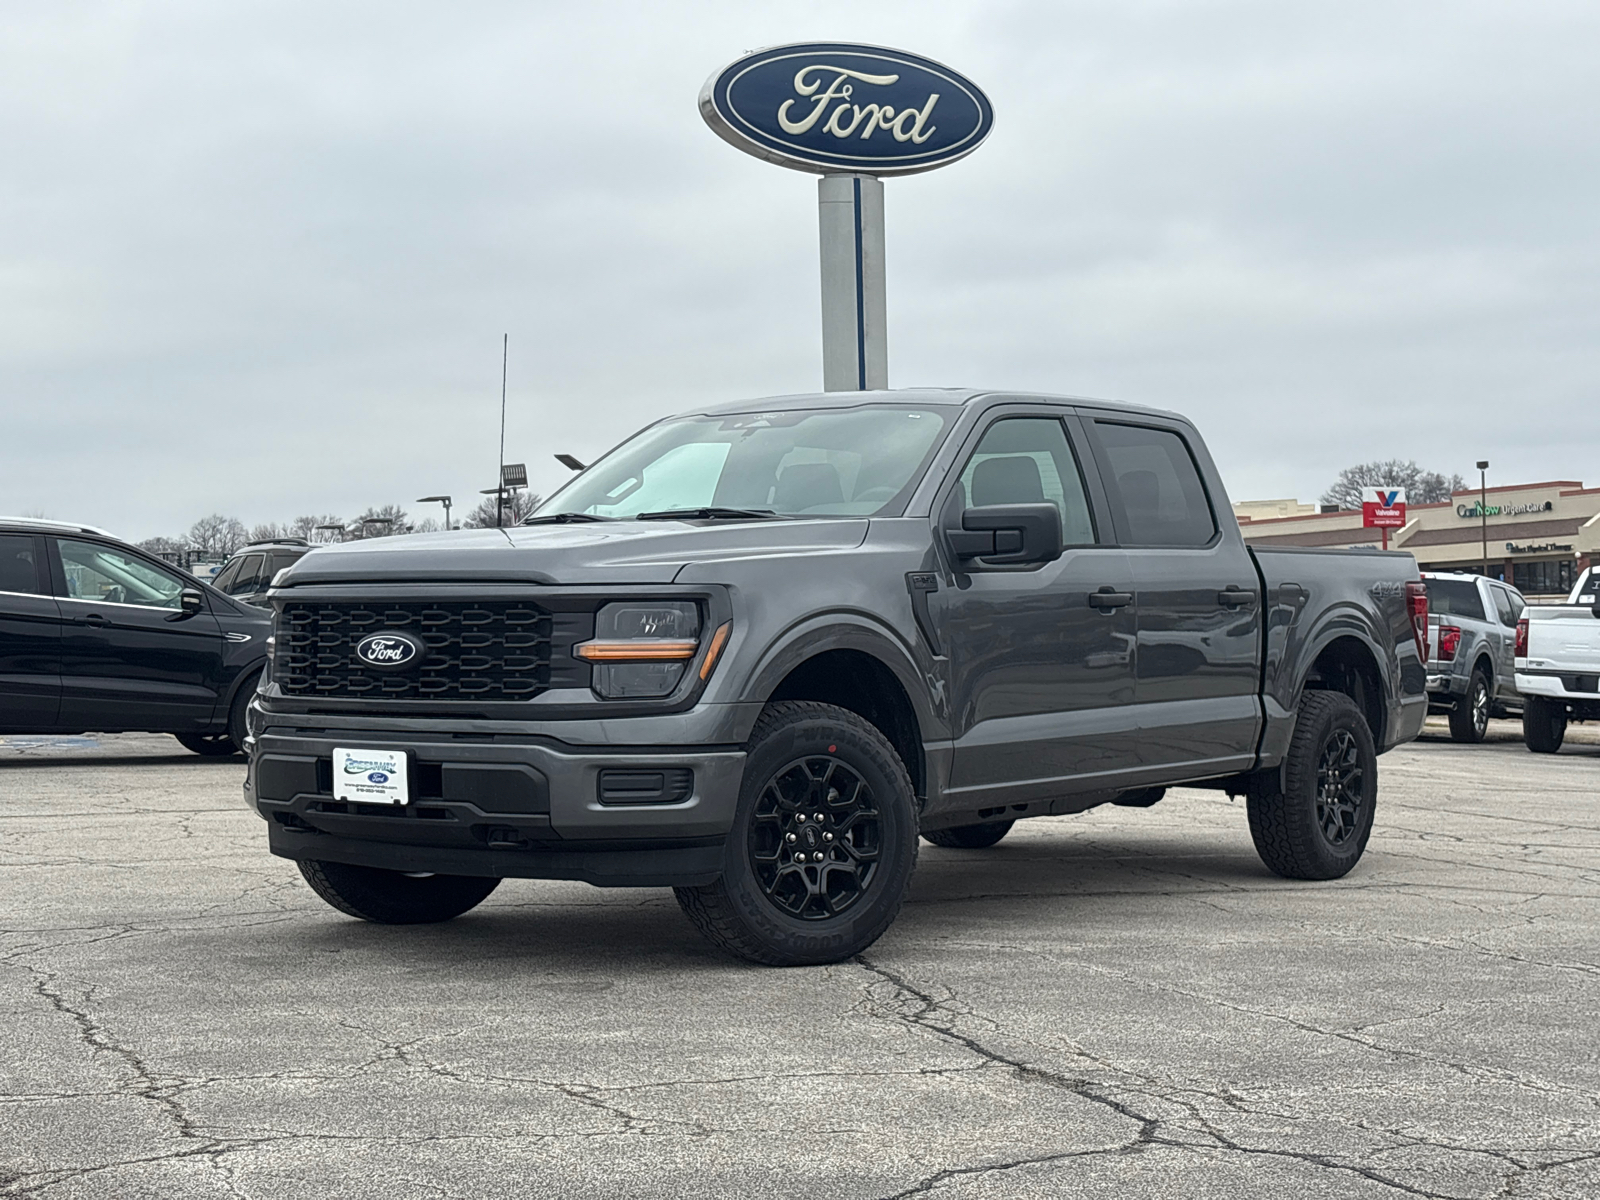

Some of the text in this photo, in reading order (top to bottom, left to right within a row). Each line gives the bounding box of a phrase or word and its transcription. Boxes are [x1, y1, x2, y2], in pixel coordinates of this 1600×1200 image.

[777, 64, 941, 145] Ford
[1502, 503, 1526, 516] Urgent
[1526, 502, 1545, 513] Care
[367, 639, 404, 660] Ford
[795, 726, 898, 787] WRANGLER
[371, 773, 385, 782] Ford
